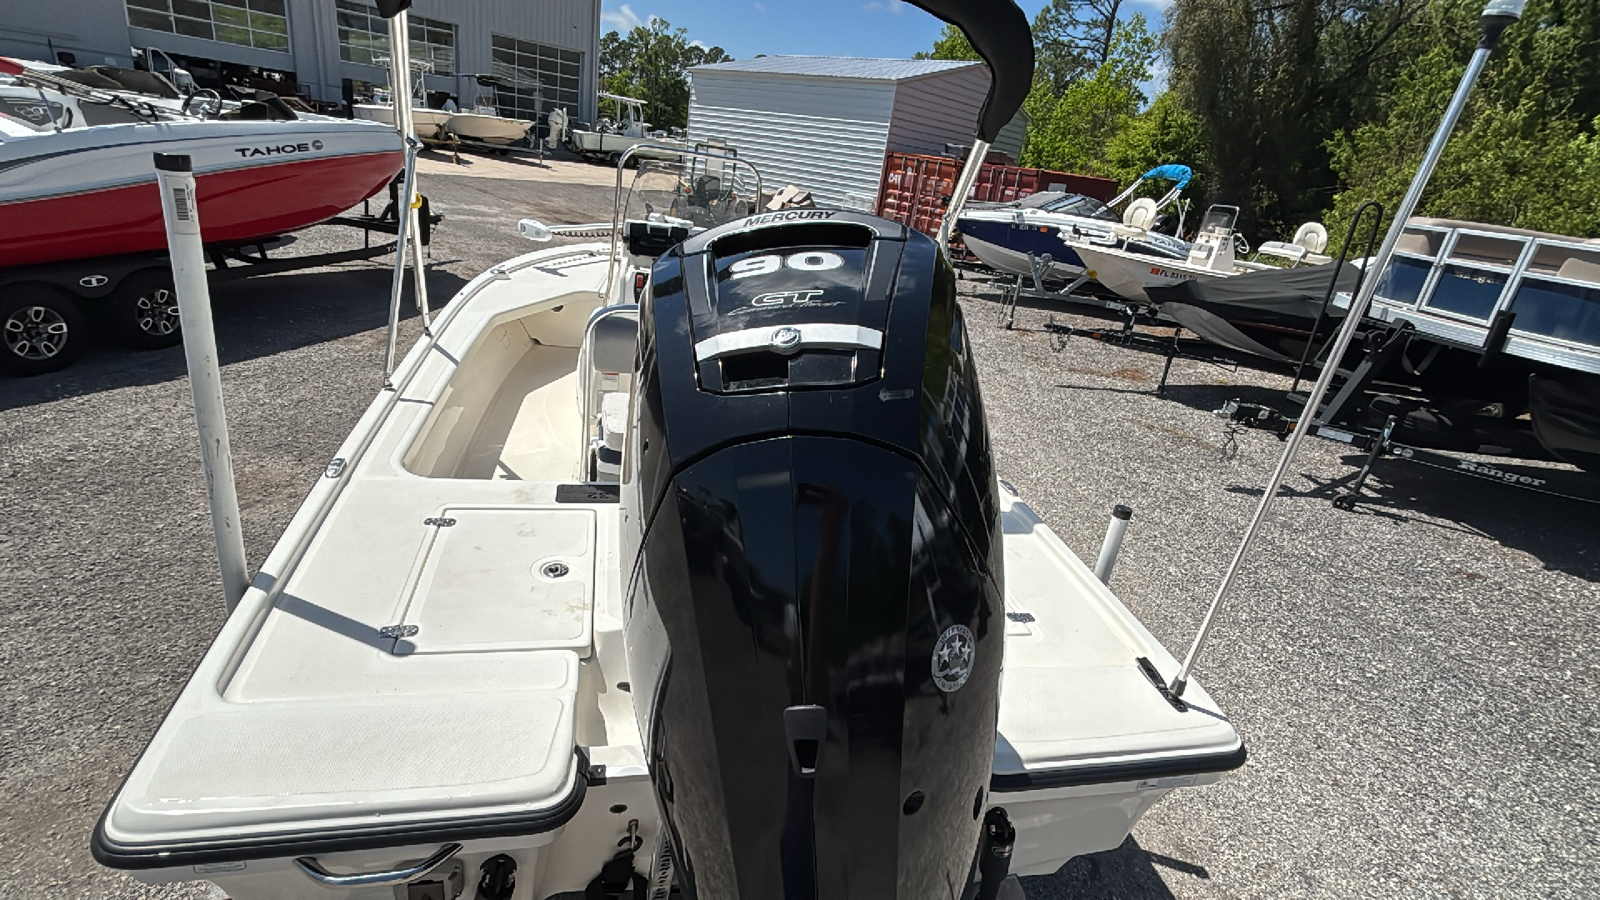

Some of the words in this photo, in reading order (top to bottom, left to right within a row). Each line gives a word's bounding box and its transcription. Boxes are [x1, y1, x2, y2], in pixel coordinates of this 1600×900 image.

[234, 143, 310, 157] TAHOE
[744, 211, 837, 227] MERCURY
[729, 252, 845, 280] 90
[752, 290, 824, 306] GT
[1457, 460, 1546, 485] Ranger
